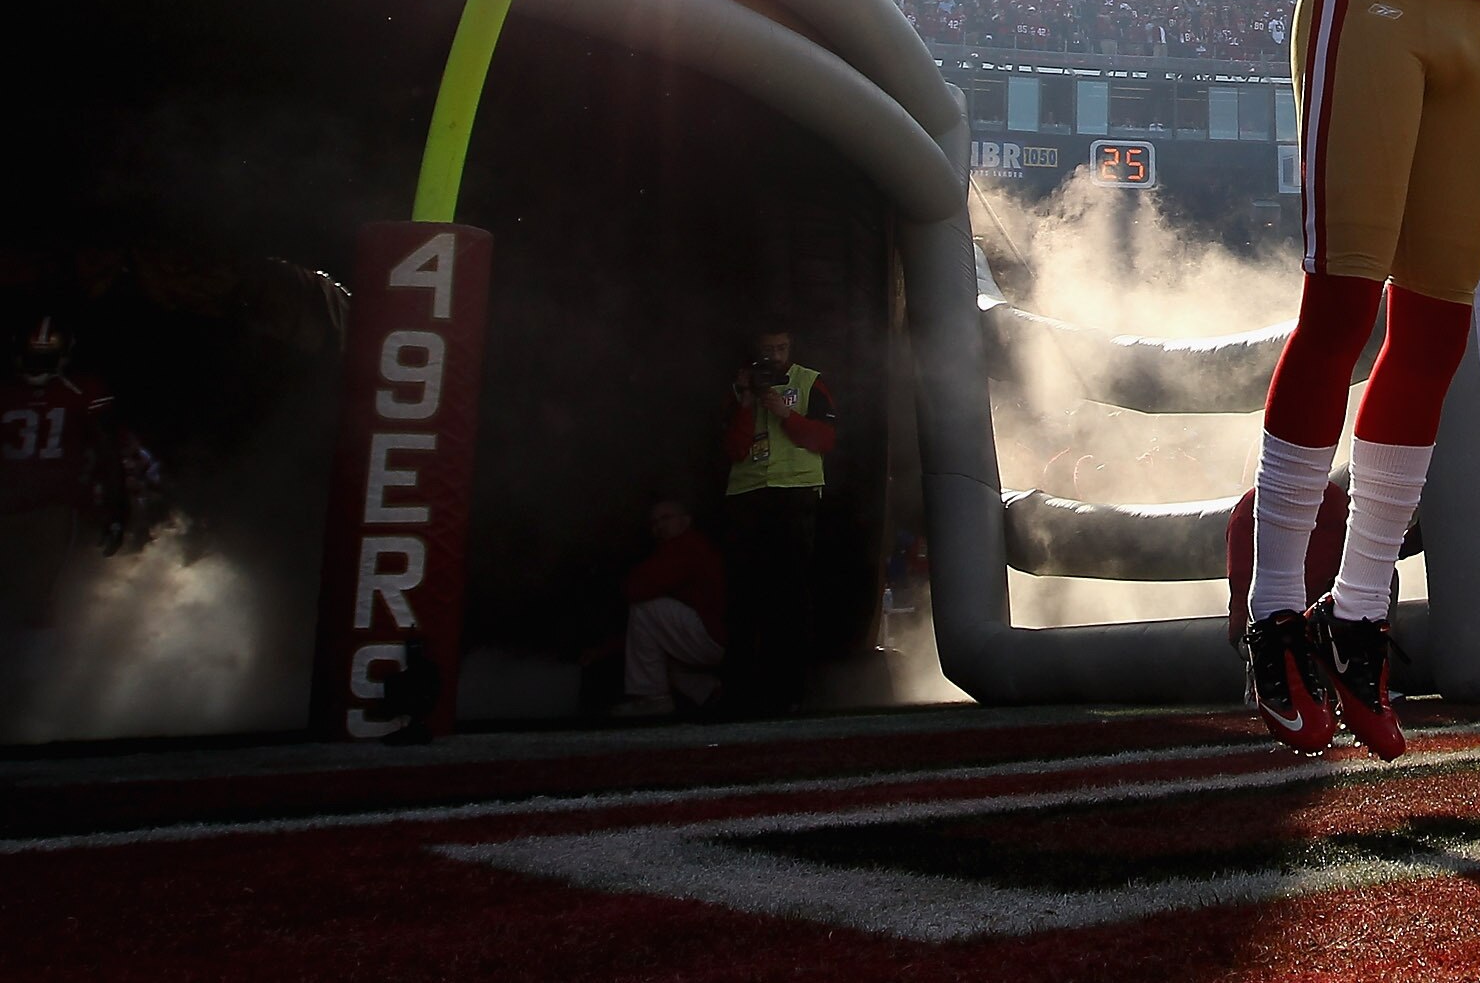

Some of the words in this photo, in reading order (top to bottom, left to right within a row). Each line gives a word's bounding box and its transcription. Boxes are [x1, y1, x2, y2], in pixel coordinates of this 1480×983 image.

[1024, 148, 1057, 166] 1050
[1103, 147, 1145, 181] 25
[1, 407, 66, 459] 31
